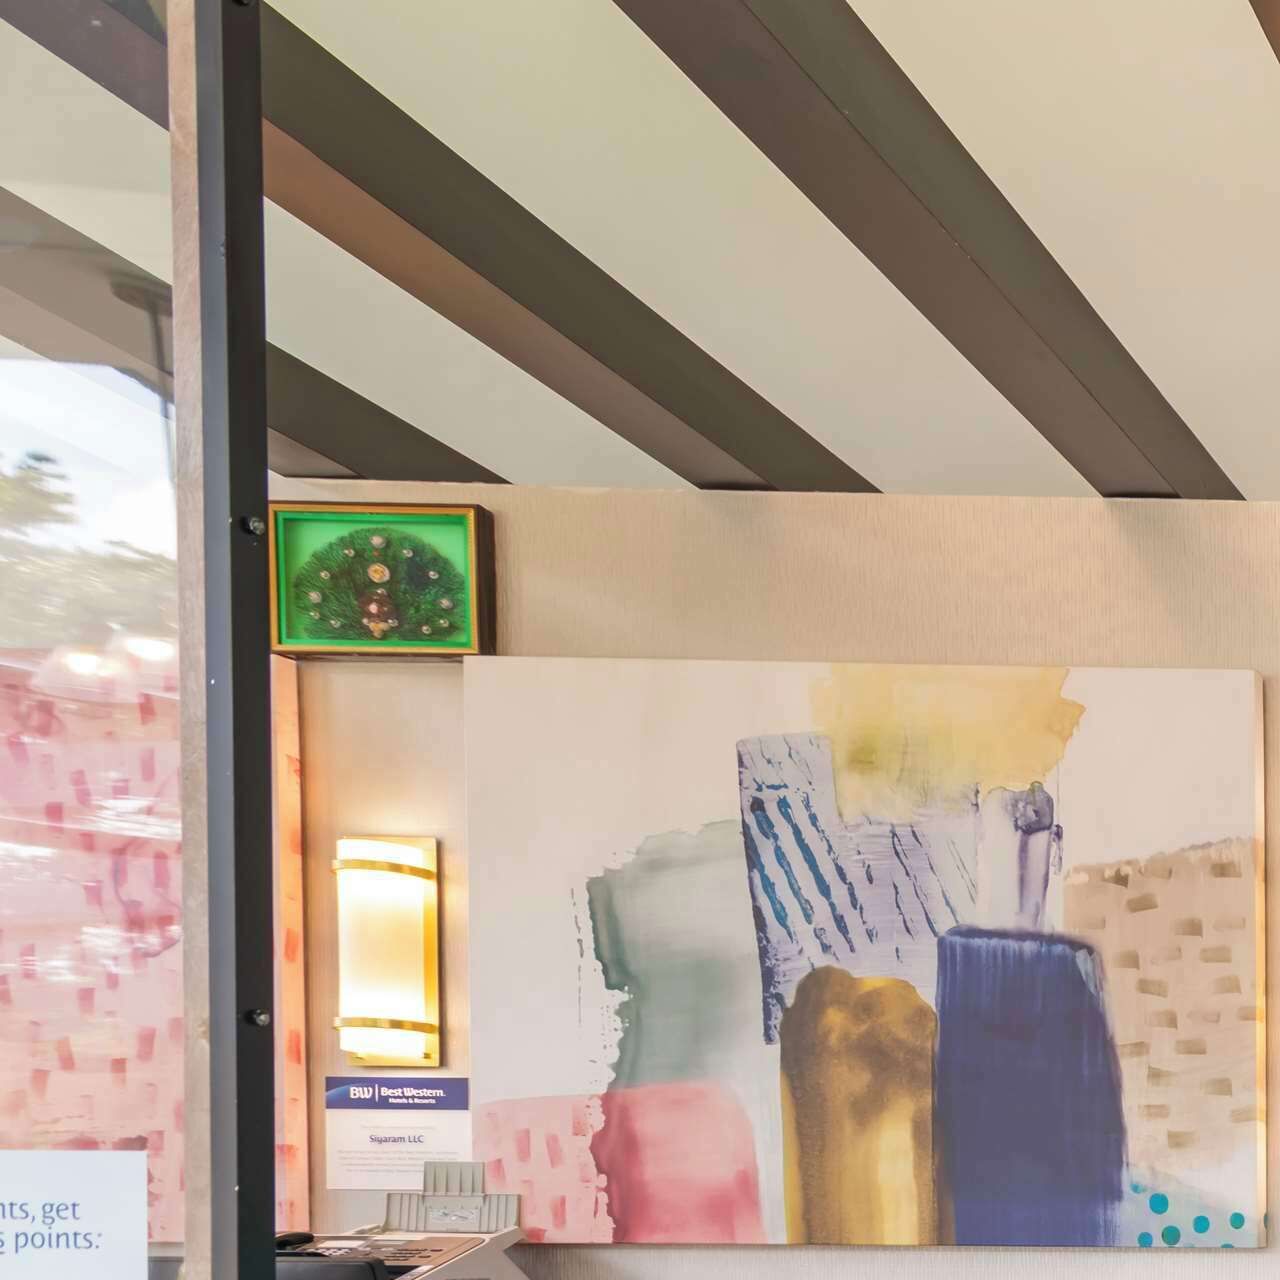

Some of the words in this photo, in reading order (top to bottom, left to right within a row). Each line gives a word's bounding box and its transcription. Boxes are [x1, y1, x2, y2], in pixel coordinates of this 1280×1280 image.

[350, 1086, 373, 1099] BW
[380, 1086, 402, 1097] Best
[408, 1135, 424, 1143] LLC
[42, 1202, 80, 1225] get
